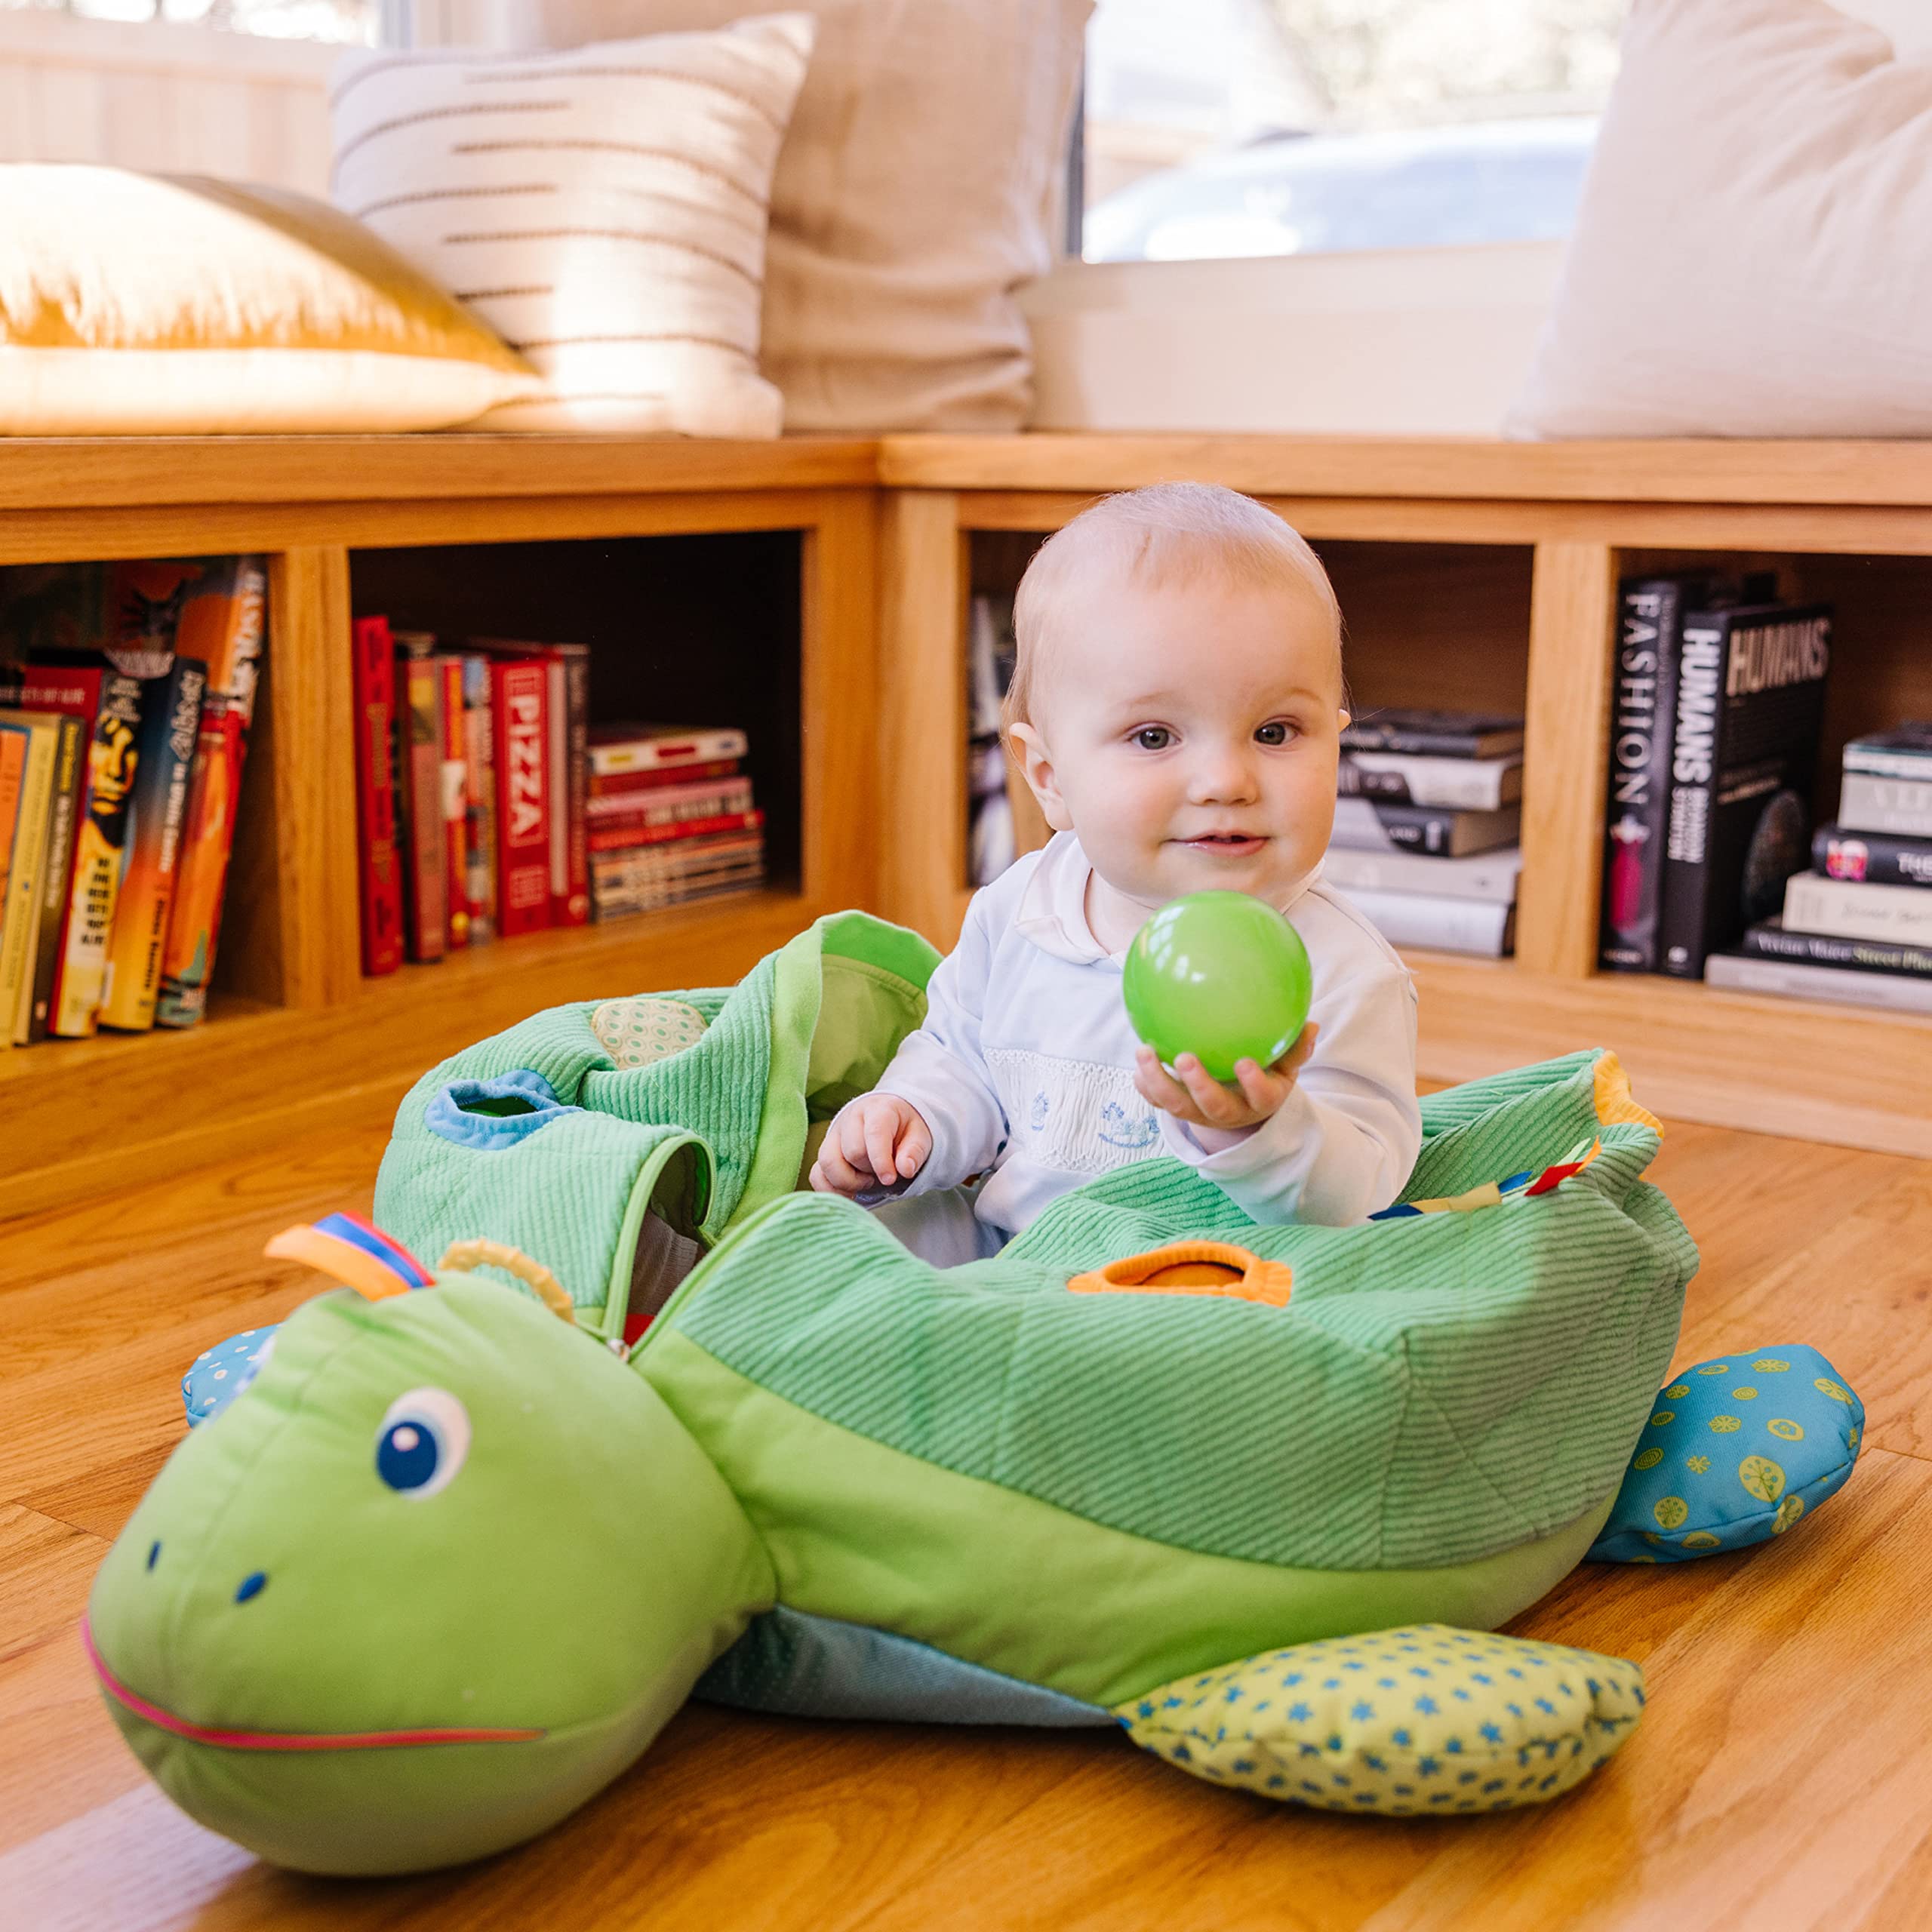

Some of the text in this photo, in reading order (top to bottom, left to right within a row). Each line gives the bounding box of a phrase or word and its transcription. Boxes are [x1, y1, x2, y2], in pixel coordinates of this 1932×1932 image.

[1614, 593, 1660, 804] FASHION
[1673, 628, 1721, 783] HUMANS
[1725, 617, 1830, 697] HUMANS
[509, 694, 543, 836] PIZZA
